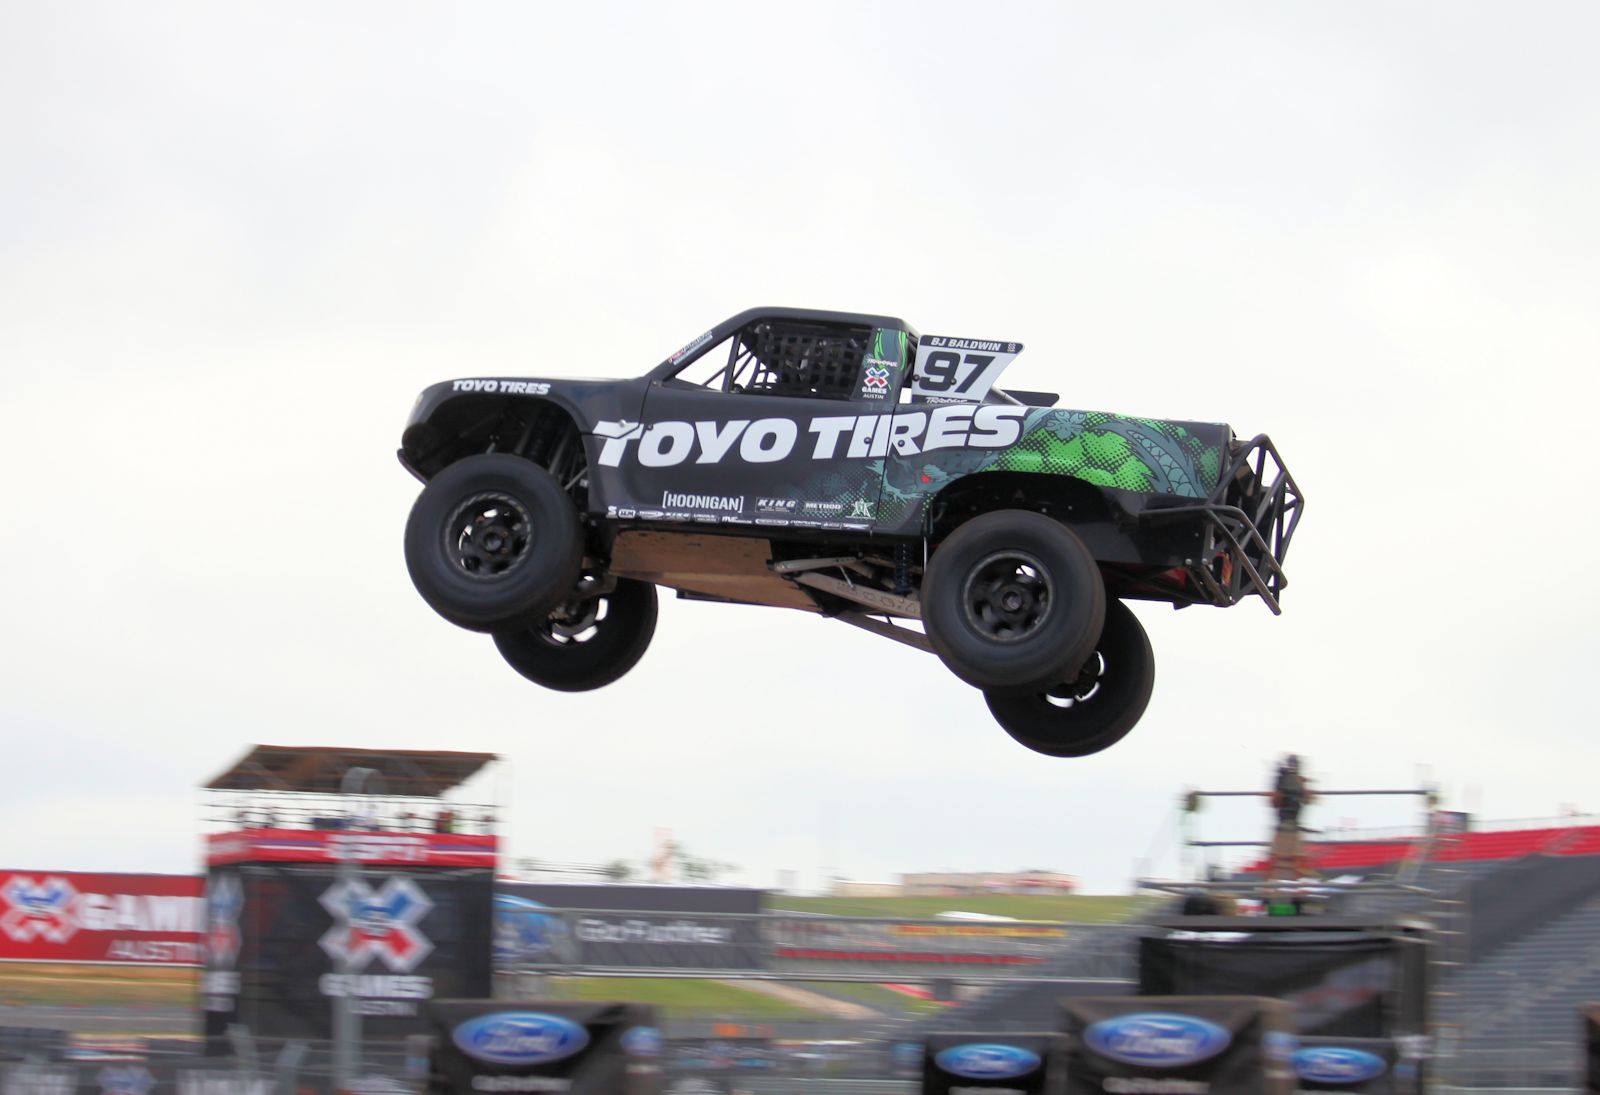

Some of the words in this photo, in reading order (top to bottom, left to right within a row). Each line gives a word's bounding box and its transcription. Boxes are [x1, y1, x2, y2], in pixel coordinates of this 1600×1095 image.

[931, 337, 948, 347] BJ
[948, 338, 1002, 352] BALDWIN
[918, 350, 996, 394] 97
[452, 379, 498, 393] TOYO
[499, 380, 552, 396] TIRES
[861, 386, 888, 395] GAMES
[592, 416, 796, 468] TOYO
[808, 404, 1029, 460] TIRES
[757, 499, 796, 508] KING
